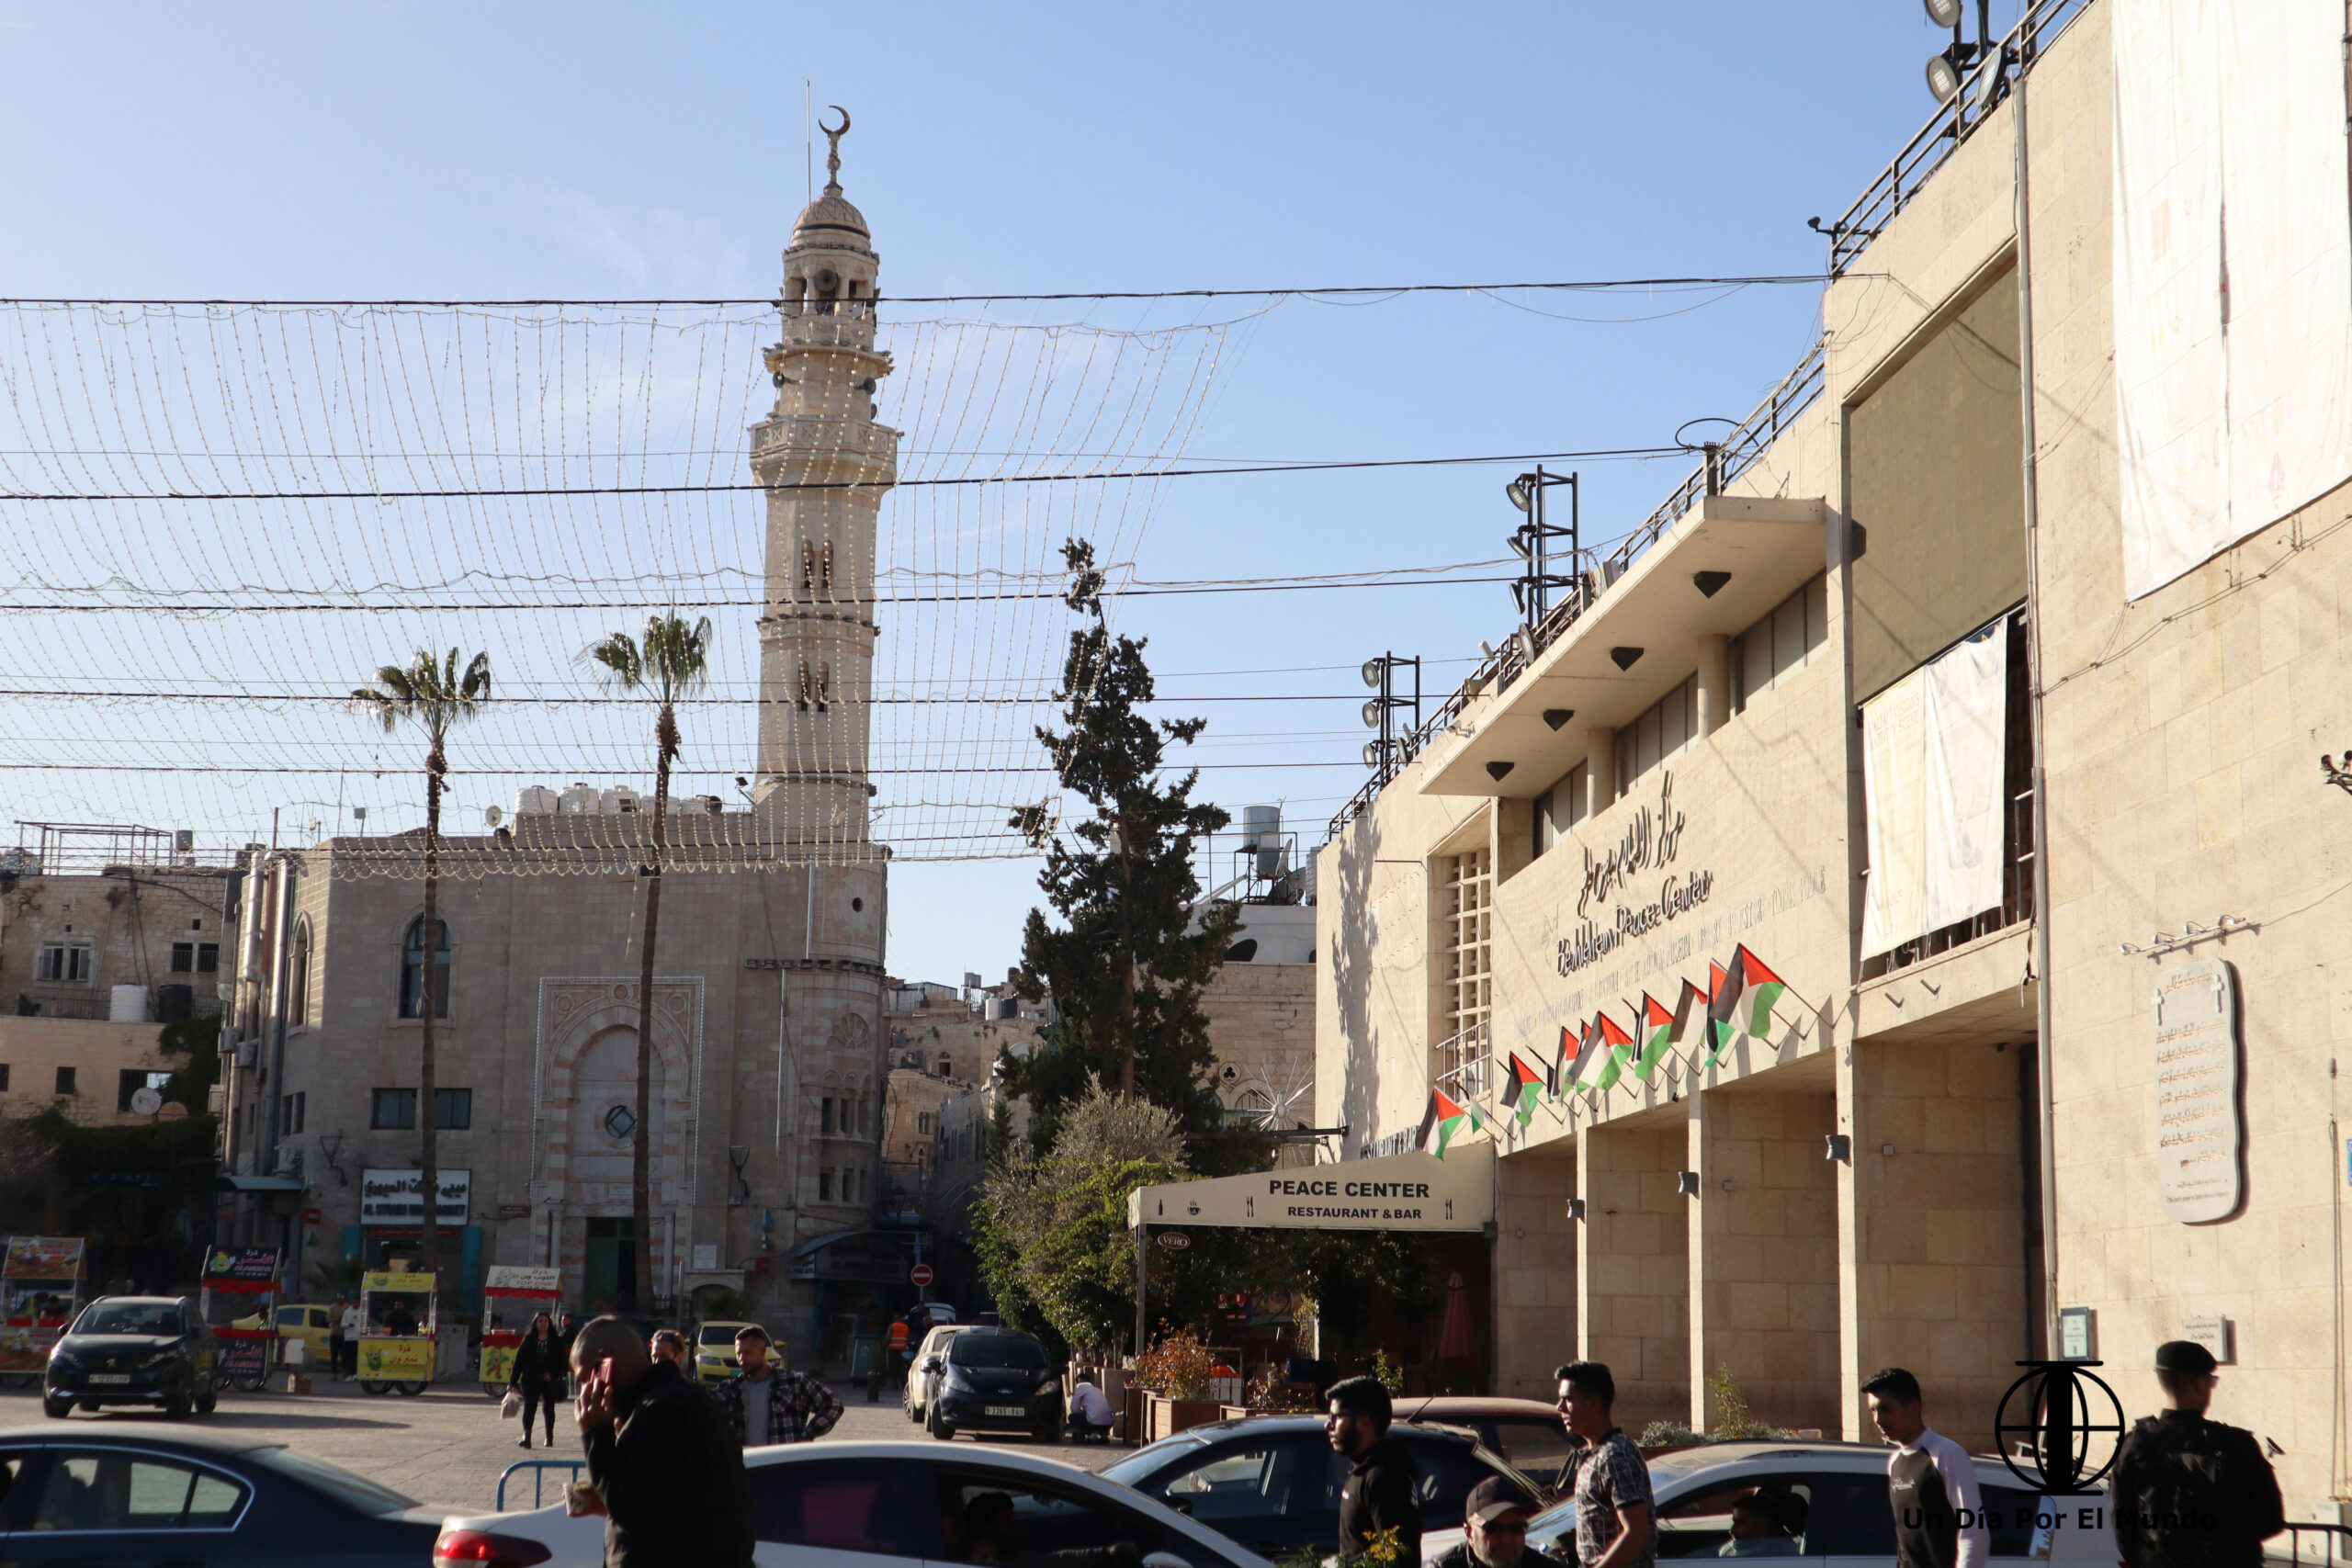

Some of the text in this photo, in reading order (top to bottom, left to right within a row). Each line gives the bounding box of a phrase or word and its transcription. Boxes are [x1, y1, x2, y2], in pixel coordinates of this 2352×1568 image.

[1557, 919, 1623, 976] Bethlehem
[1615, 904, 1660, 937] Peace
[1661, 871, 1714, 919] Center
[1404, 1124, 1419, 1154] BAR
[1269, 1180, 1430, 1198] PEACE CENTER
[1287, 1206, 1421, 1219] RESTAURANT & BAR
